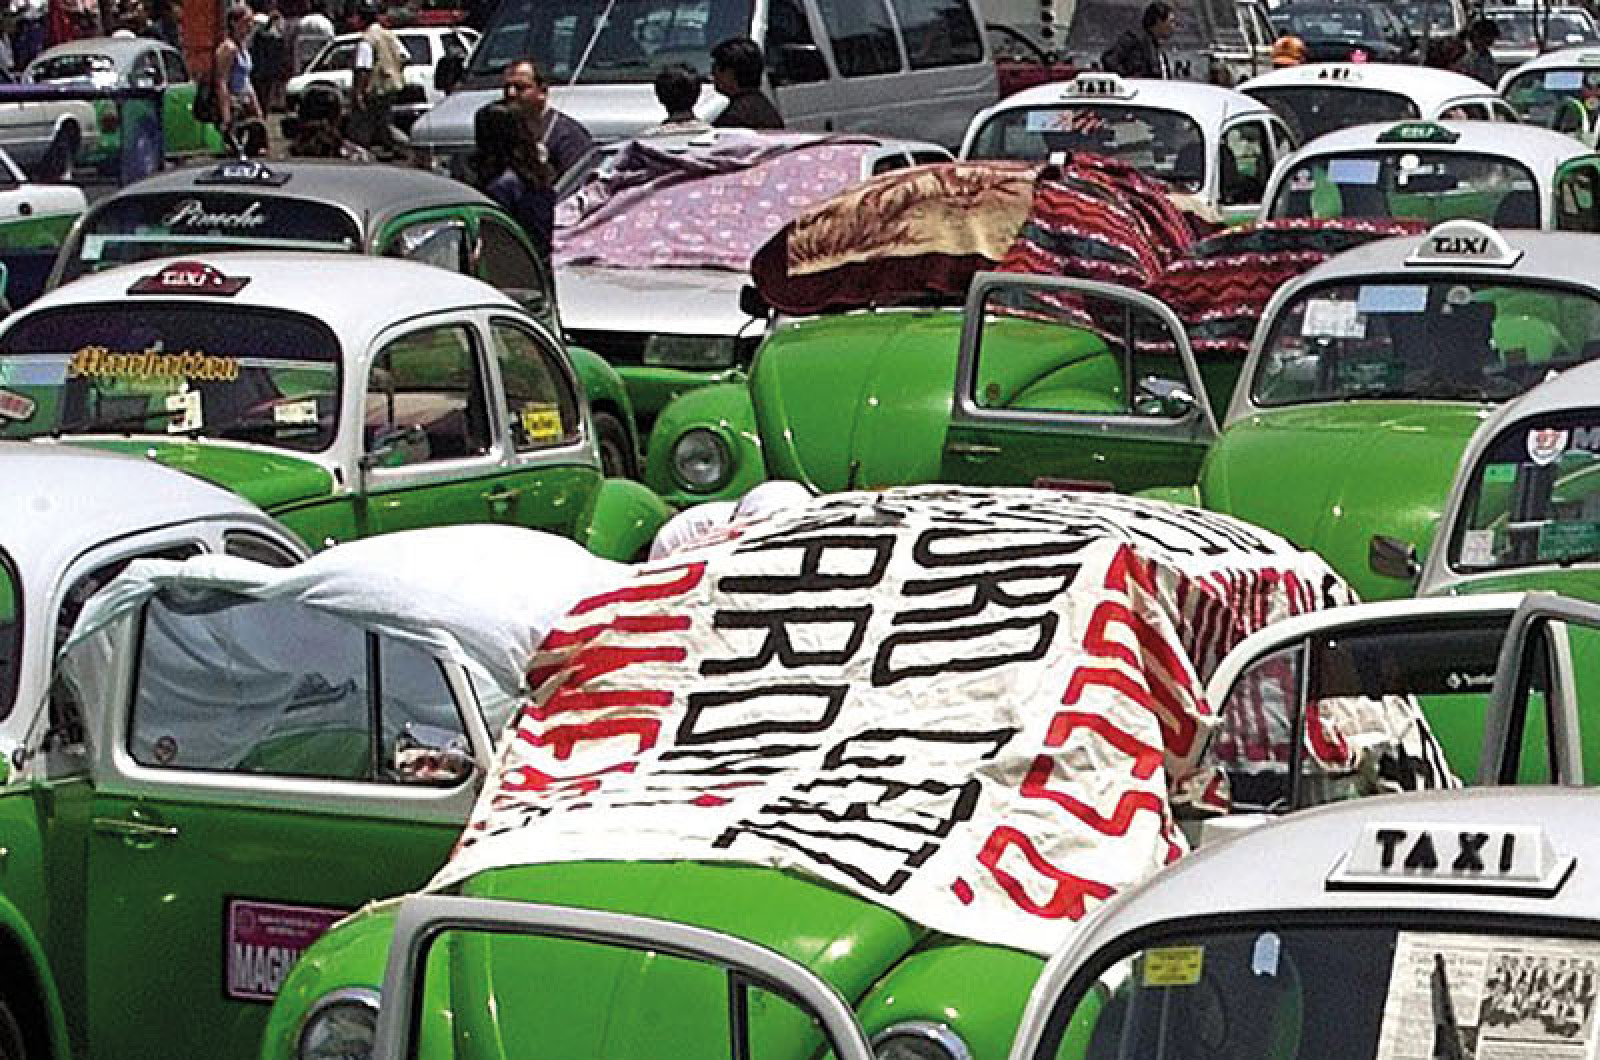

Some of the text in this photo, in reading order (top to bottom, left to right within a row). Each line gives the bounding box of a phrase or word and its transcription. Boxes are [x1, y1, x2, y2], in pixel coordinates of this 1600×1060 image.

[1077, 79, 1116, 93] TAXI
[1434, 237, 1489, 254] TAXI
[1375, 829, 1516, 873] TAXI
